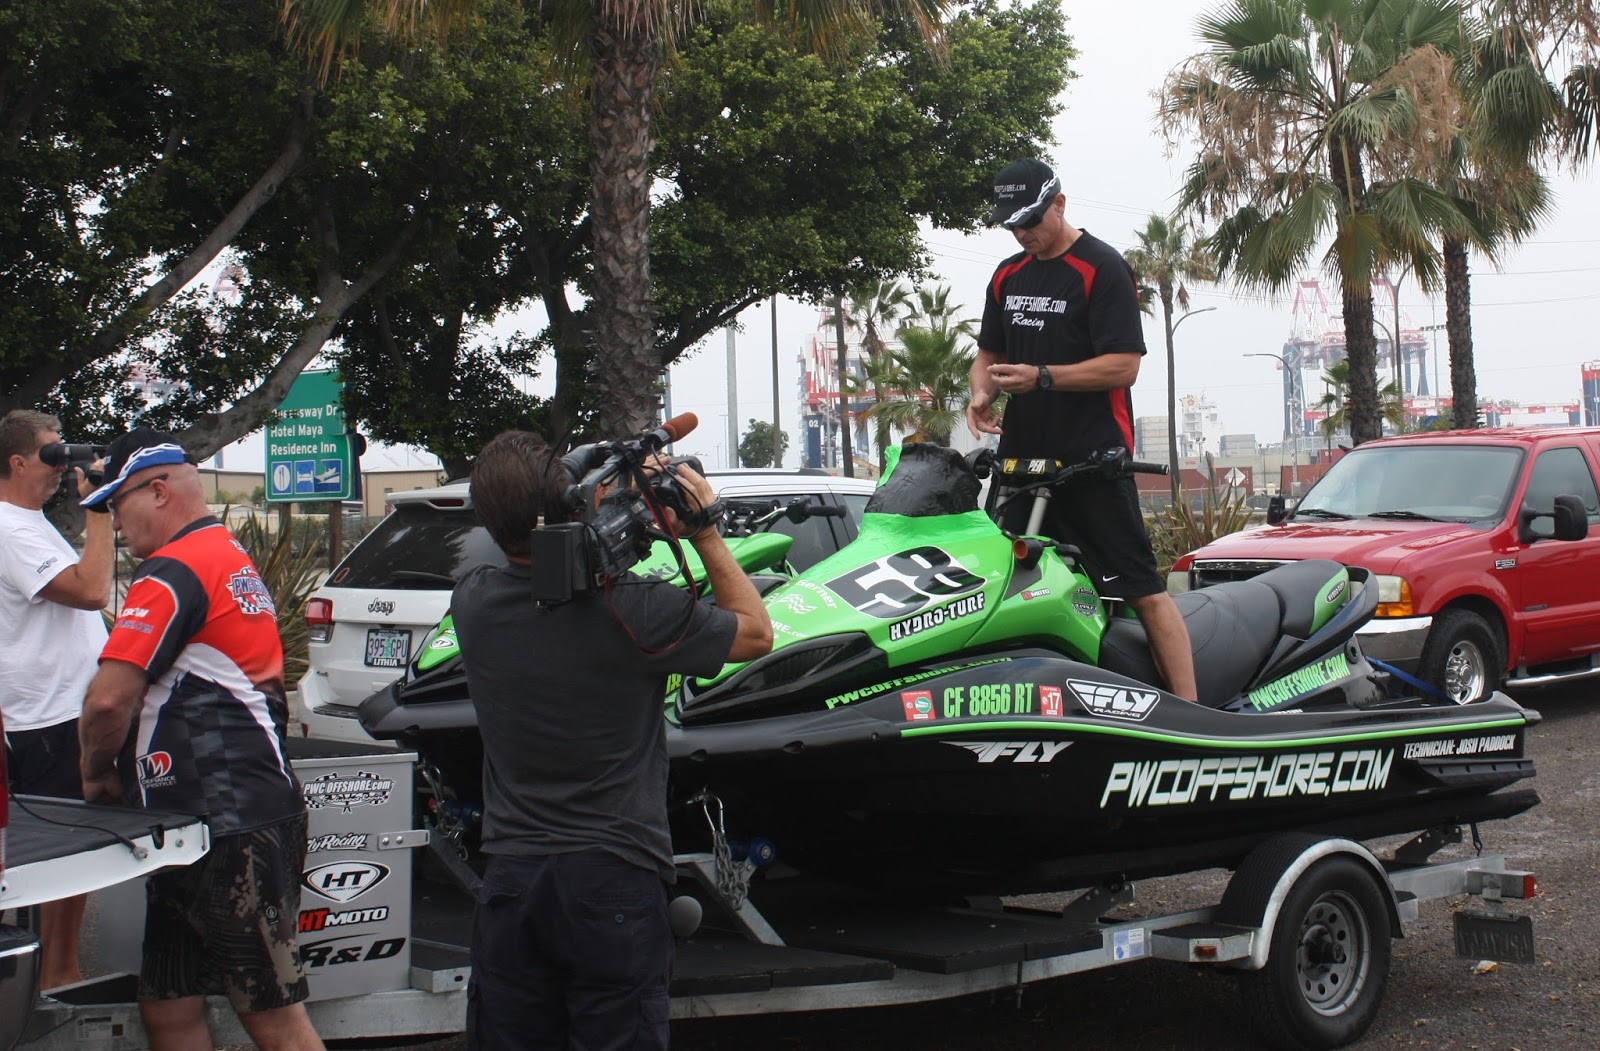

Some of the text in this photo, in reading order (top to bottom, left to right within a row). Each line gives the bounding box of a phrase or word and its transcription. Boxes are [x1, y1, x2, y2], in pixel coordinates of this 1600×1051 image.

[1012, 312, 1045, 331] Racing
[326, 404, 337, 416] Dr
[270, 424, 323, 438] Hotel Maya
[808, 419, 819, 428] 02
[270, 442, 337, 456] Residence Inn
[824, 546, 986, 618] 58
[368, 598, 395, 616] Jeep
[889, 591, 986, 642] HYDRO-TURF
[368, 638, 408, 658] 395 GPU
[373, 658, 398, 667] LITHIA
[1248, 652, 1350, 711] PWCOFFSHORE.COM
[943, 683, 1034, 718] CF 8856 RT
[1047, 691, 1061, 710] 17
[1069, 682, 1158, 713] FLY
[1093, 707, 1141, 718] RACING
[965, 741, 1075, 763] FLY
[1455, 738, 1479, 755] JOSH
[1478, 734, 1516, 753] PADDOCK
[303, 780, 391, 795] PWC OFFSHORE.com
[1100, 748, 1394, 809] PWCOFFSHORE.COM
[307, 833, 367, 853] ly Racing
[322, 870, 371, 888] HT
